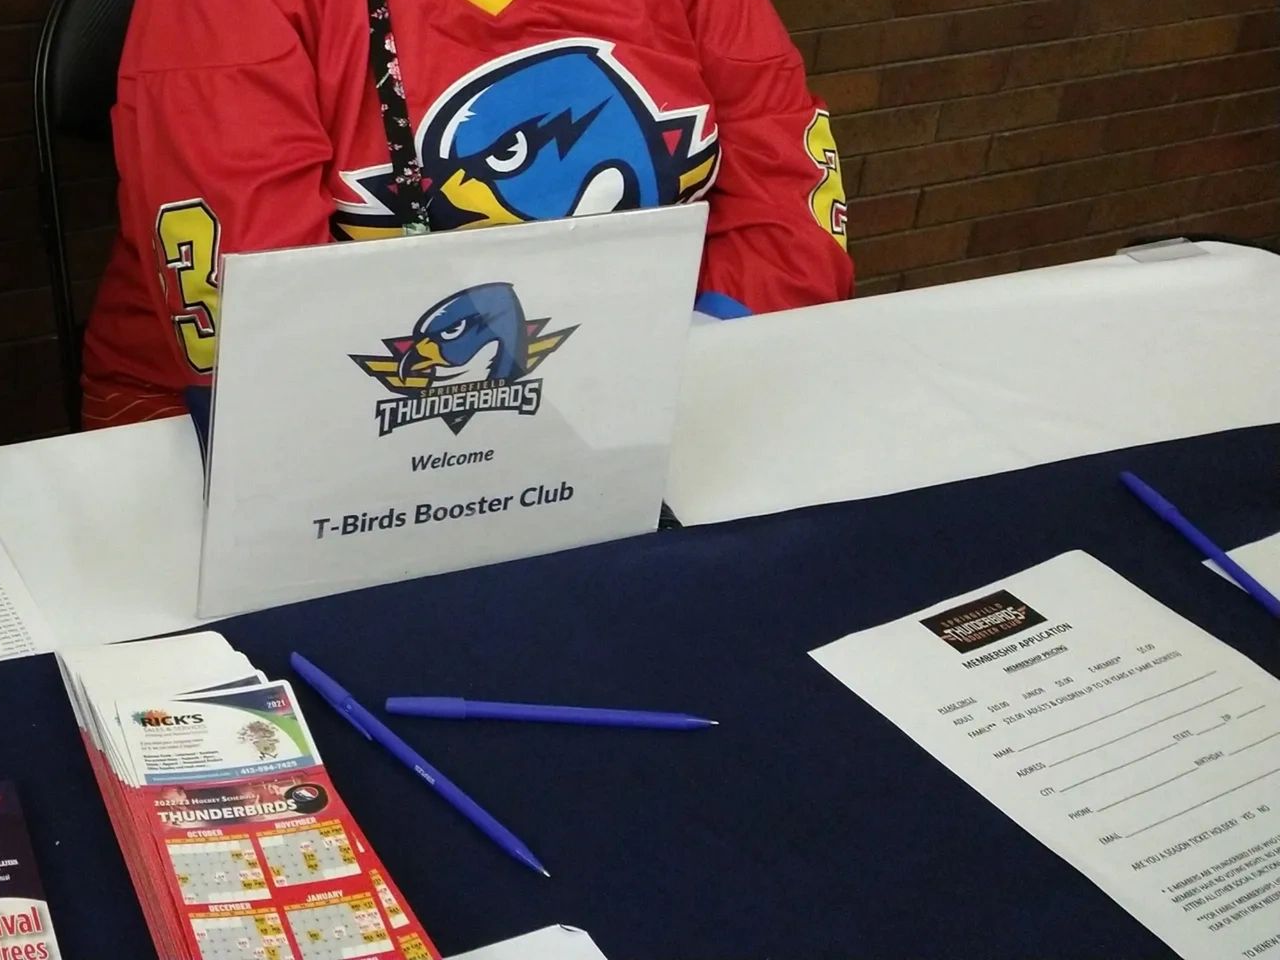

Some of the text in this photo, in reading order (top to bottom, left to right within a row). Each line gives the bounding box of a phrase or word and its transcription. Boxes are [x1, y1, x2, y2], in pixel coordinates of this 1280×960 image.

[420, 379, 505, 398] SPRINGFIELD
[378, 382, 539, 432] THUNDERBIRDS
[411, 449, 494, 471] Welcome
[313, 481, 574, 539] T-Birds Booster Club
[943, 606, 1025, 642] THUNDERBIRDS
[961, 623, 1073, 670] MEMBERSHIP APPLICATION
[1003, 653, 1041, 673] MEMBERSHIP
[953, 714, 974, 726] ADULT
[986, 701, 1010, 713] $10.00
[1022, 687, 1046, 700] JUNIOR
[1003, 712, 1025, 725] $25.00
[1056, 687, 1085, 706] CHILDREN
[141, 713, 204, 727] RICK'S
[993, 747, 1015, 759] NAME
[1039, 787, 1055, 797] CITY
[1172, 730, 1194, 742] STATE
[1016, 762, 1046, 778] ADDRESS
[157, 799, 297, 823] THUNDERBIRDS
[1068, 806, 1093, 820] PHONE
[187, 817, 317, 838] OCTOBER NOVEMBER
[1131, 860, 1147, 872] ARE
[1145, 855, 1161, 865] YOU
[1164, 841, 1191, 857] SEASON
[1188, 832, 1213, 846] TICKET
[1241, 811, 1255, 821] YES
[1257, 804, 1271, 814] NO
[208, 890, 343, 912] DECEMBER JANUARY
[1242, 937, 1279, 958] TO RENEW
